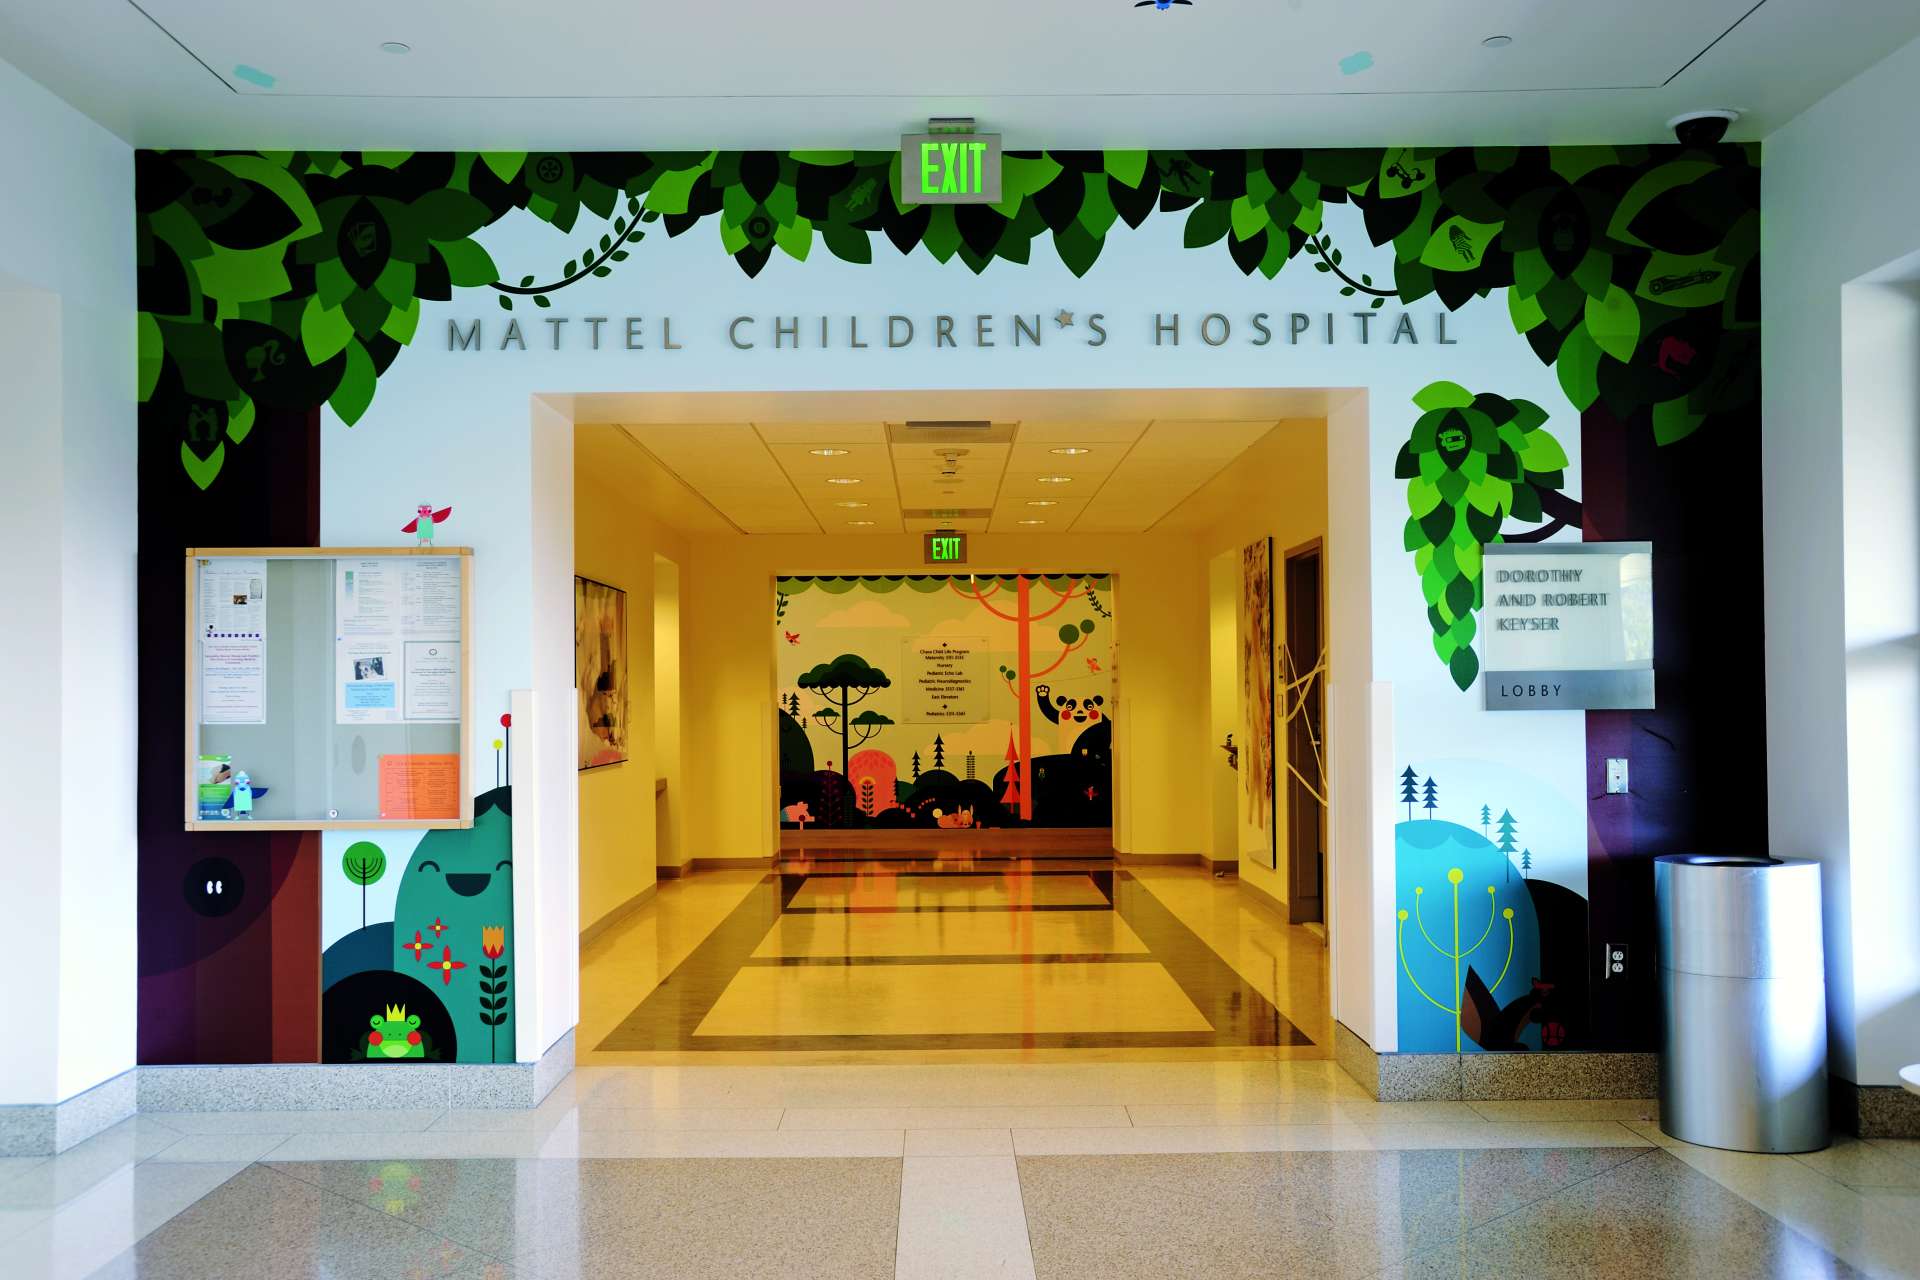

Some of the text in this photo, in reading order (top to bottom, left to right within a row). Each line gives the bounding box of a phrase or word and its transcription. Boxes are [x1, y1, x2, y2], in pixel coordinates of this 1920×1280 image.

[921, 143, 987, 194] EXIT
[447, 316, 683, 352] MATTEL
[1153, 311, 1458, 347] HOSPITAL
[932, 537, 961, 560] EXIT
[1496, 569, 1583, 583] DOROTHY
[1497, 592, 1610, 607] AND ROBERT
[1496, 617, 1560, 631] KEYSER
[1501, 684, 1562, 697] LOBBY
